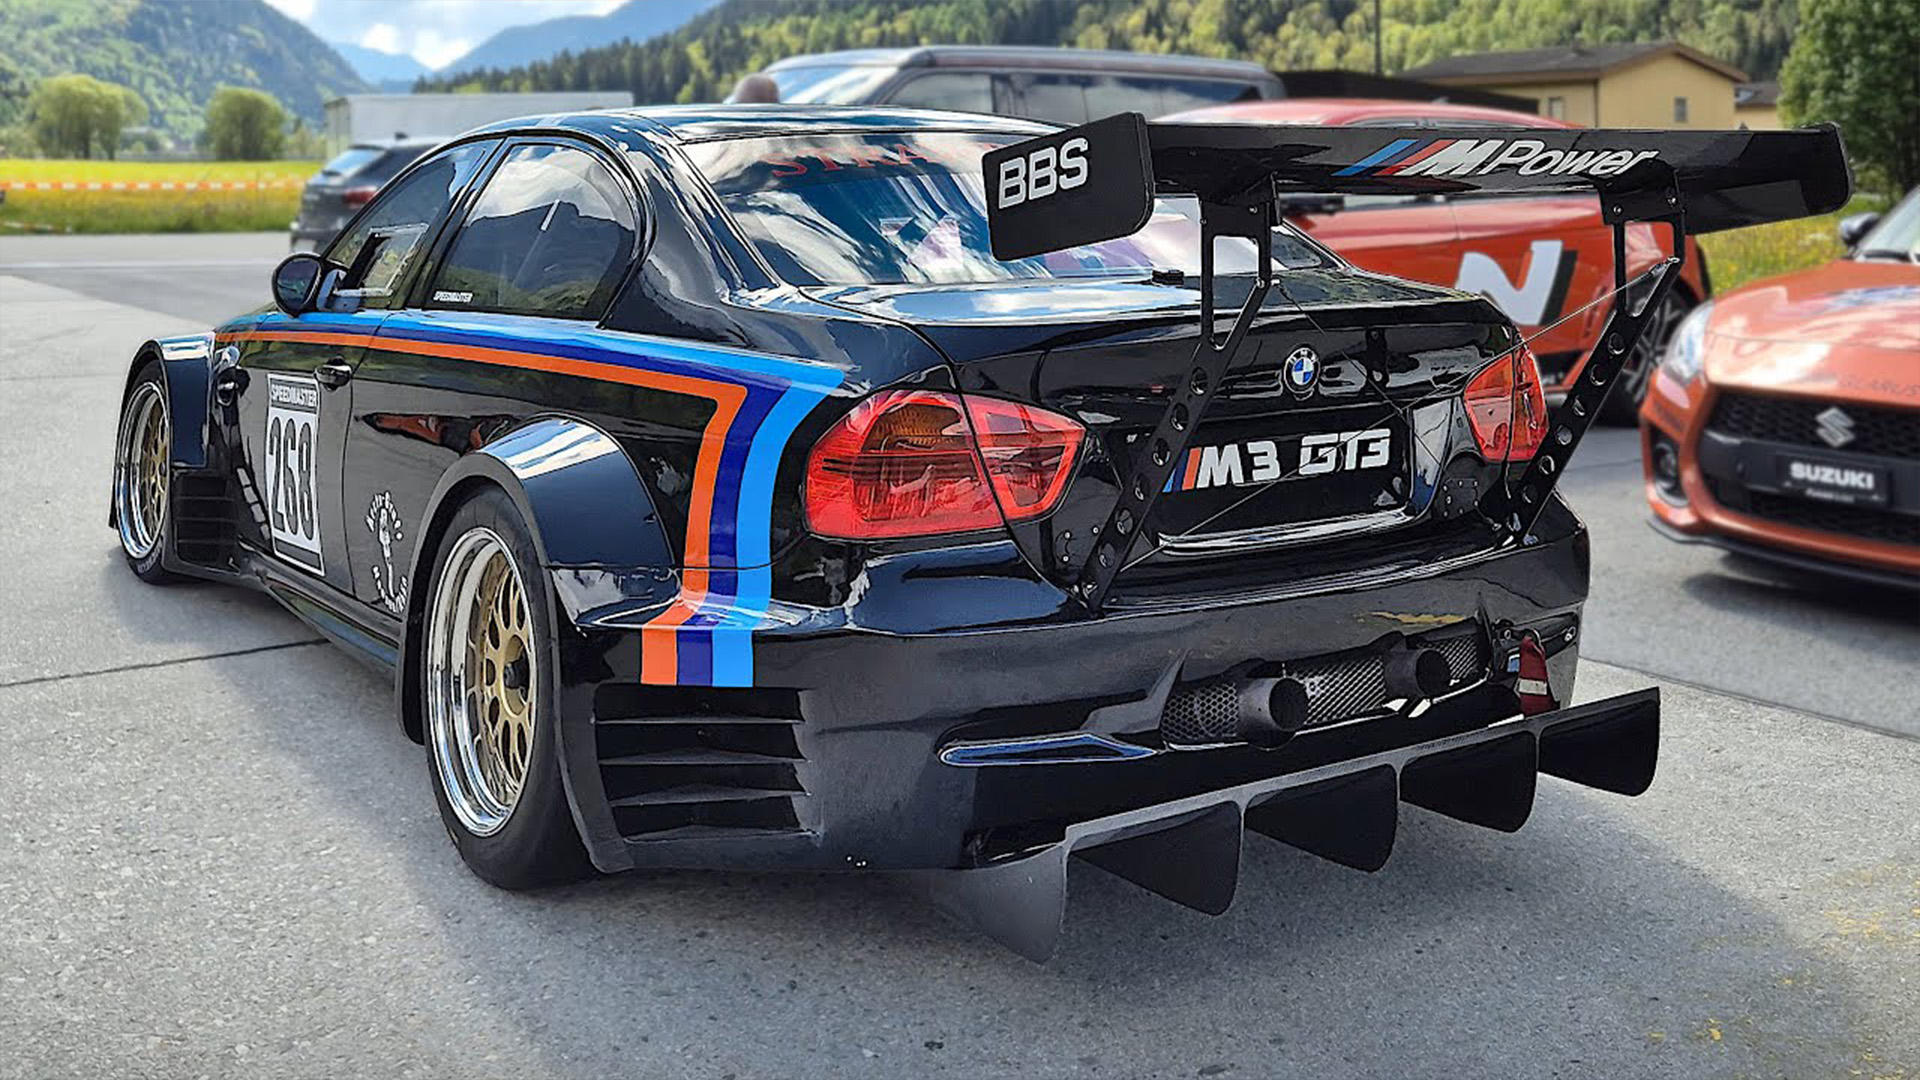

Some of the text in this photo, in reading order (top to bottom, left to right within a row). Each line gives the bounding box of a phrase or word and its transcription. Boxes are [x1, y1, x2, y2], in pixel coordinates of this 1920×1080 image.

[999, 137, 1088, 209] BBS
[269, 416, 315, 541] 268
[1790, 461, 1875, 490] SUZUKI
